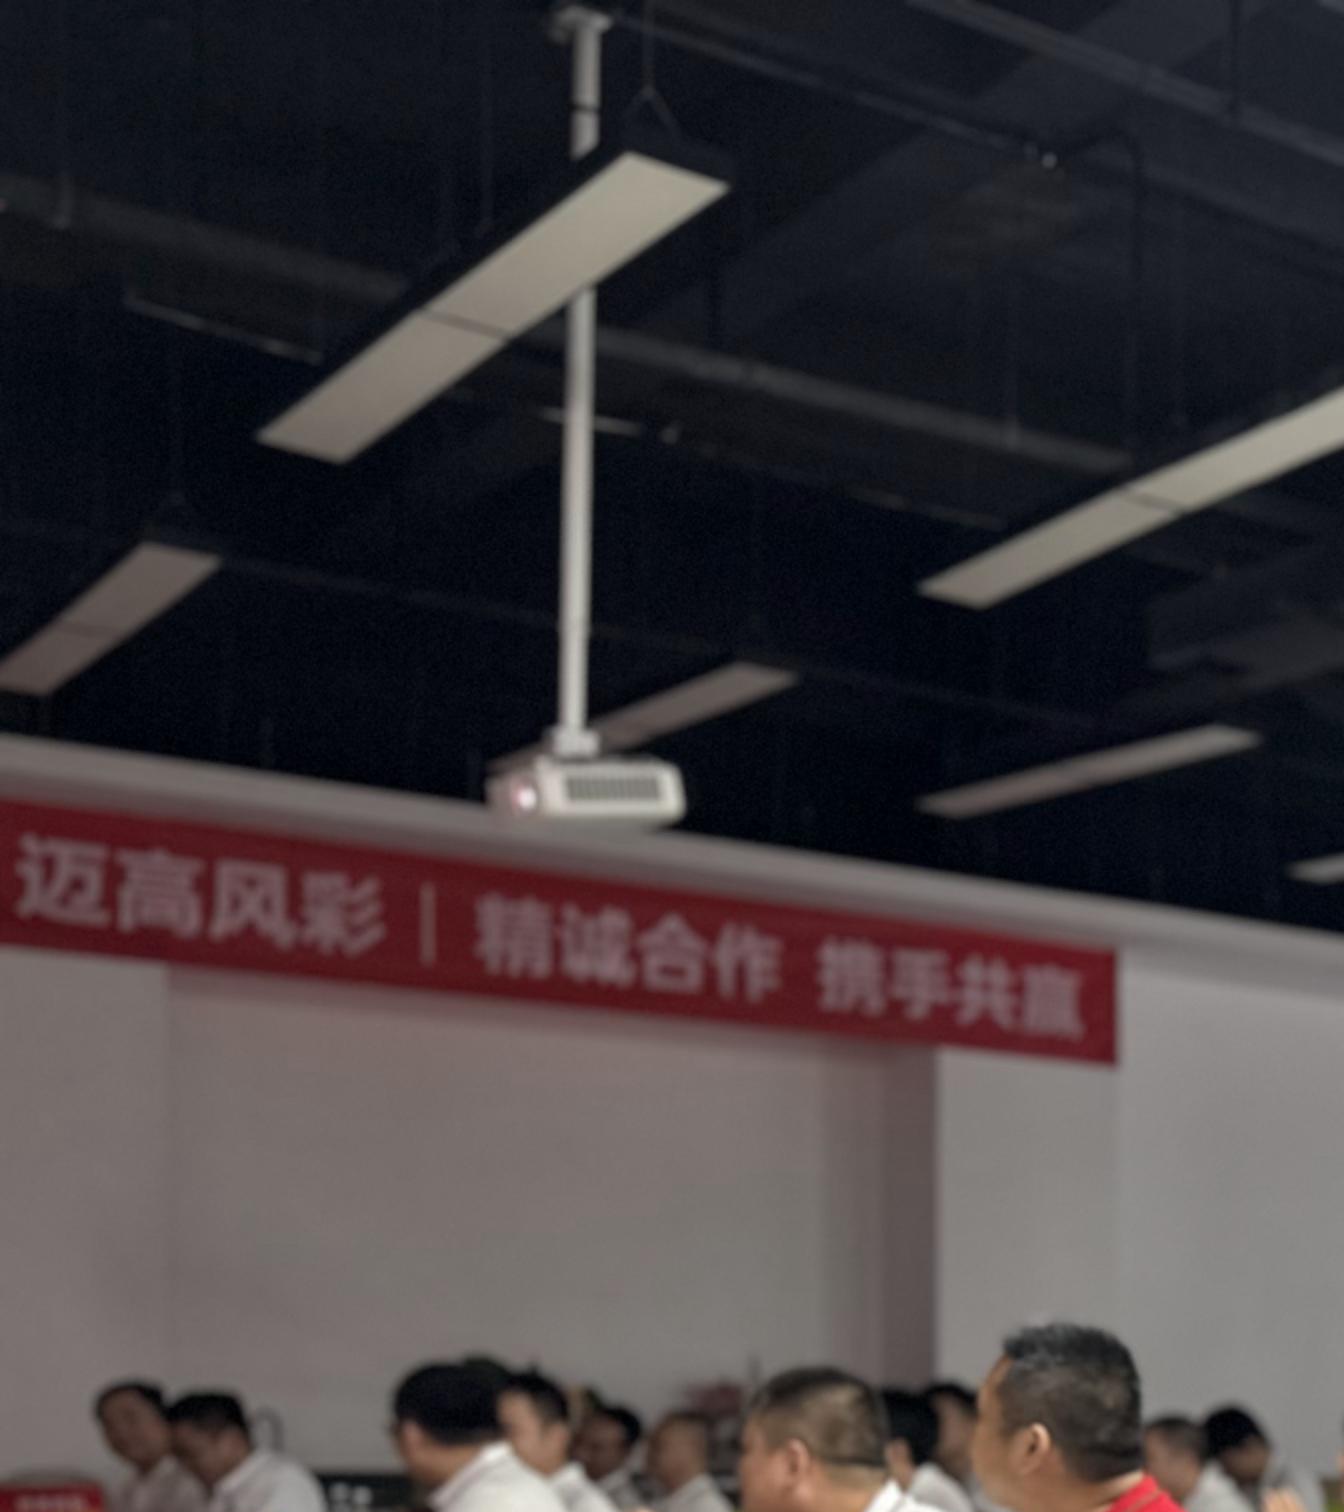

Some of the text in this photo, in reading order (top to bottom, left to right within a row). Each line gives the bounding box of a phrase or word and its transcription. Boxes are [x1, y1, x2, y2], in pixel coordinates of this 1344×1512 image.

[16, 834, 1085, 1039] 迈高风彩 精诚合作 携手共赢
